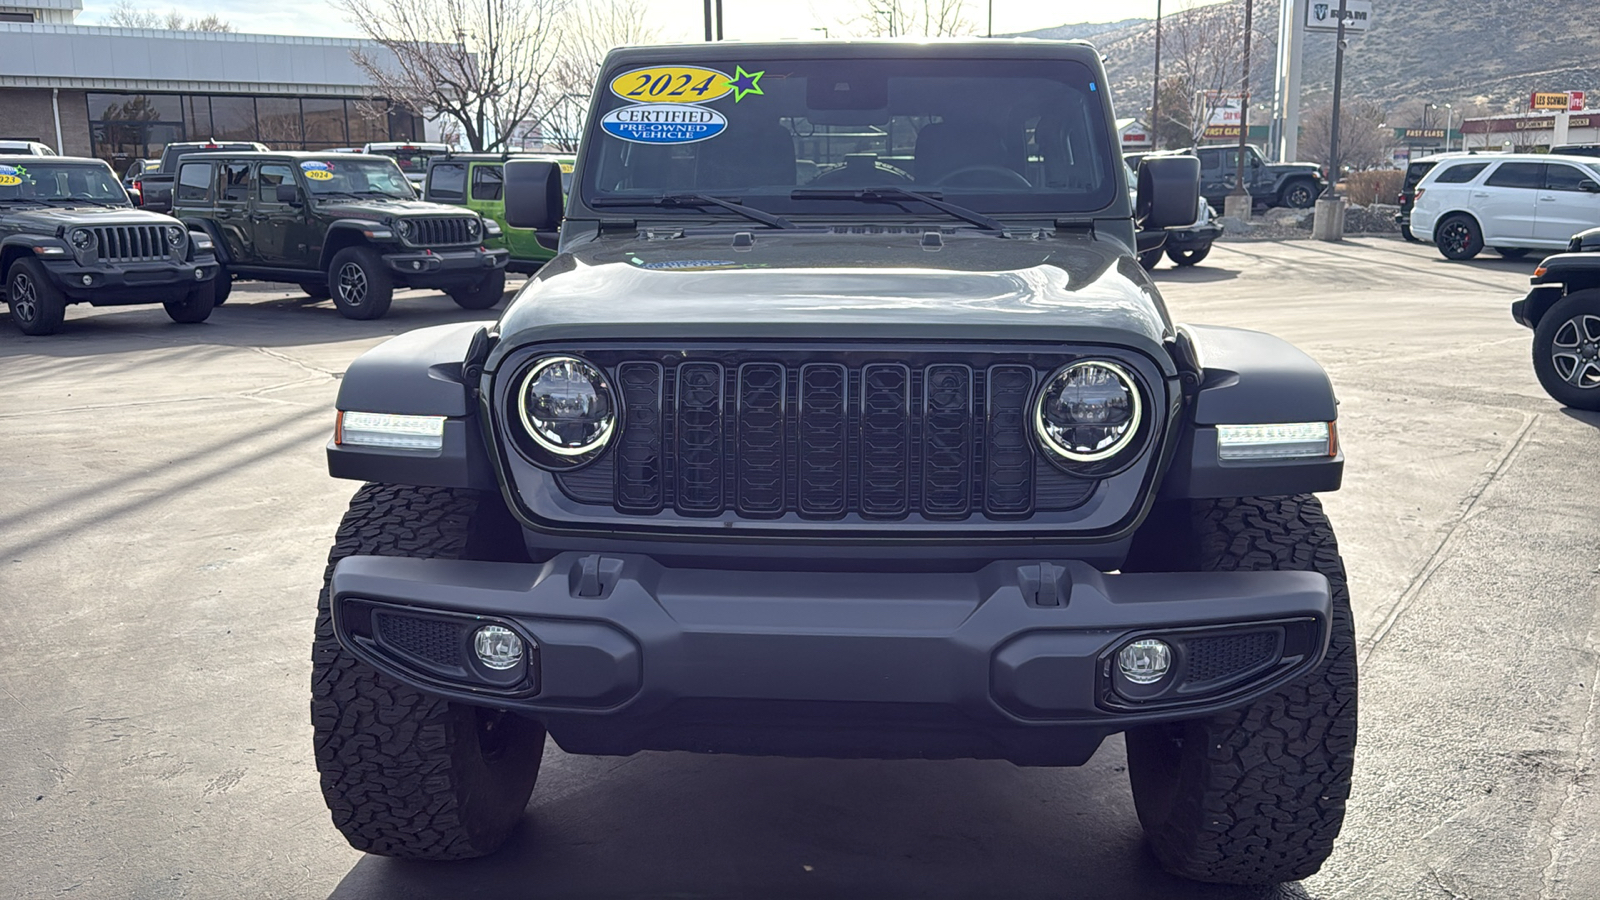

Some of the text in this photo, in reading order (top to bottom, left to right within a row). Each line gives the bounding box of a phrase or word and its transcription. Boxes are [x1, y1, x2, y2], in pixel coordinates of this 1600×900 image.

[1330, 9, 1367, 20] RAM
[626, 73, 717, 97] 2024
[1536, 95, 1568, 106] LES SCHWAB
[616, 110, 713, 123] CERTIFIED
[619, 124, 708, 132] PRE-OWNED
[1205, 127, 1224, 136] FAST
[632, 131, 694, 139] VEHICLE
[1423, 130, 1444, 138] CLASS
